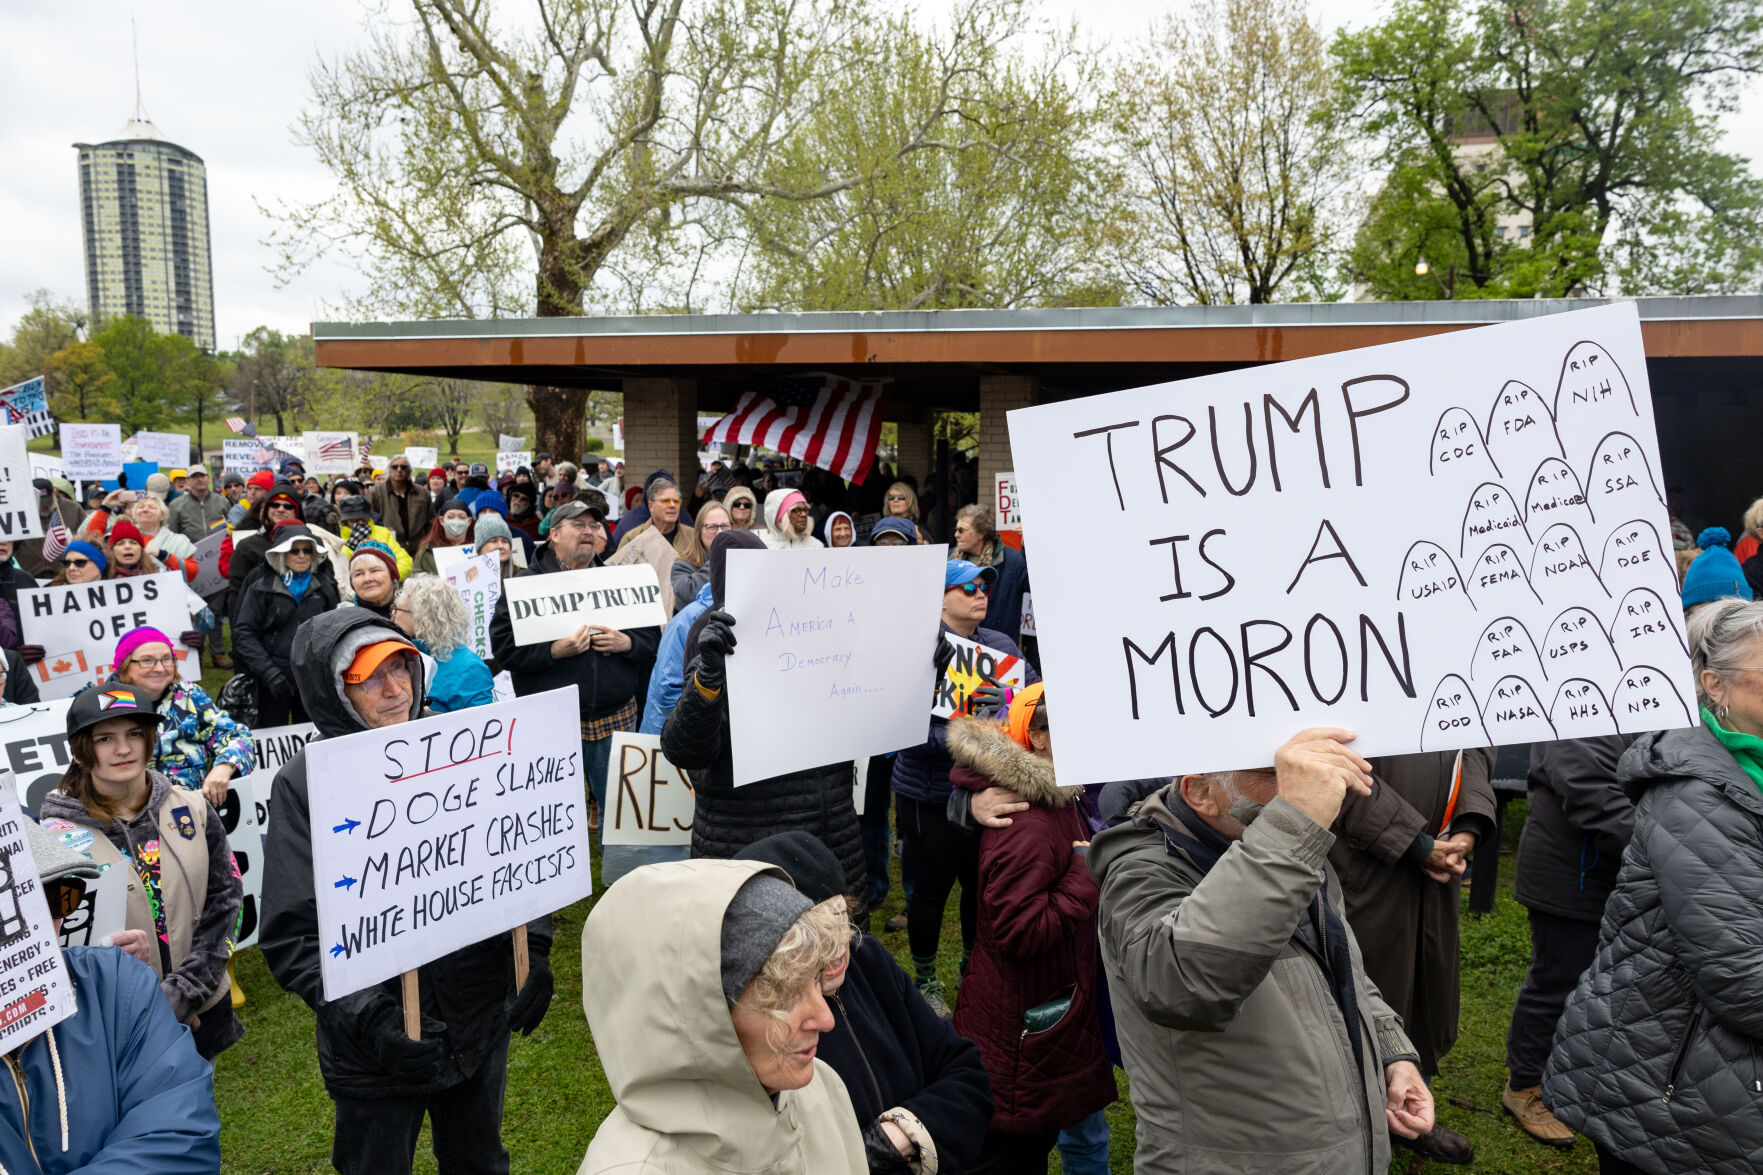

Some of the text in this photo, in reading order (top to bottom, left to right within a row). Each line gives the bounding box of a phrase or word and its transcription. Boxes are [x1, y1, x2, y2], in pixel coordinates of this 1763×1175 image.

[1570, 354, 1599, 371] RIP
[1504, 390, 1528, 406] RIP
[1572, 379, 1612, 404] NIH
[1440, 422, 1467, 441] RIP
[1504, 415, 1536, 435] FDA
[1074, 374, 1410, 511] TRUMP
[1440, 444, 1475, 462] CDC
[1603, 448, 1631, 465] RIP
[226, 466, 266, 474] RECLAI
[1538, 469, 1568, 485] RIP
[1605, 475, 1638, 494] SSA
[1474, 494, 1500, 511] RIP
[1469, 514, 1521, 537] Medicaid
[1543, 536, 1570, 553] RIP
[1615, 531, 1639, 547] RIP
[1149, 519, 1368, 602] IS A
[1411, 553, 1437, 572] RIP
[1485, 550, 1508, 566] RIP
[1545, 553, 1591, 577] NOAA
[1617, 550, 1651, 568] DOE
[803, 566, 865, 595] Make
[1411, 577, 1457, 599] USAID
[1480, 569, 1520, 588] FEMA
[32, 579, 159, 617] HANDS
[512, 585, 660, 620] DUMP TRUMP
[847, 611, 856, 625] A
[1627, 601, 1652, 616] RIP
[89, 611, 149, 641] OFF
[474, 591, 486, 659] CHECKS
[1487, 625, 1513, 642] RIP
[1560, 617, 1587, 633] RIP
[1630, 620, 1666, 638] IRS
[1491, 645, 1523, 660] FAA
[1549, 640, 1589, 659] USPS
[956, 643, 996, 682] NO
[1122, 612, 1417, 719] MORON
[1498, 684, 1522, 699] RIP
[1565, 685, 1590, 700] RIP
[1627, 676, 1651, 690] RIP
[1436, 694, 1462, 709] RIP
[1628, 697, 1660, 713] NPS
[1496, 706, 1540, 722] NASA
[1569, 705, 1599, 719] HHS
[0, 732, 70, 775] ET
[384, 718, 516, 780] STOP!
[366, 752, 577, 840] DOGE SLASHES
[359, 803, 575, 899] MARKET CRASHES
[413, 875, 484, 930] HOUSE
[492, 845, 576, 899] FASCISTS
[28, 956, 58, 981] FREE
